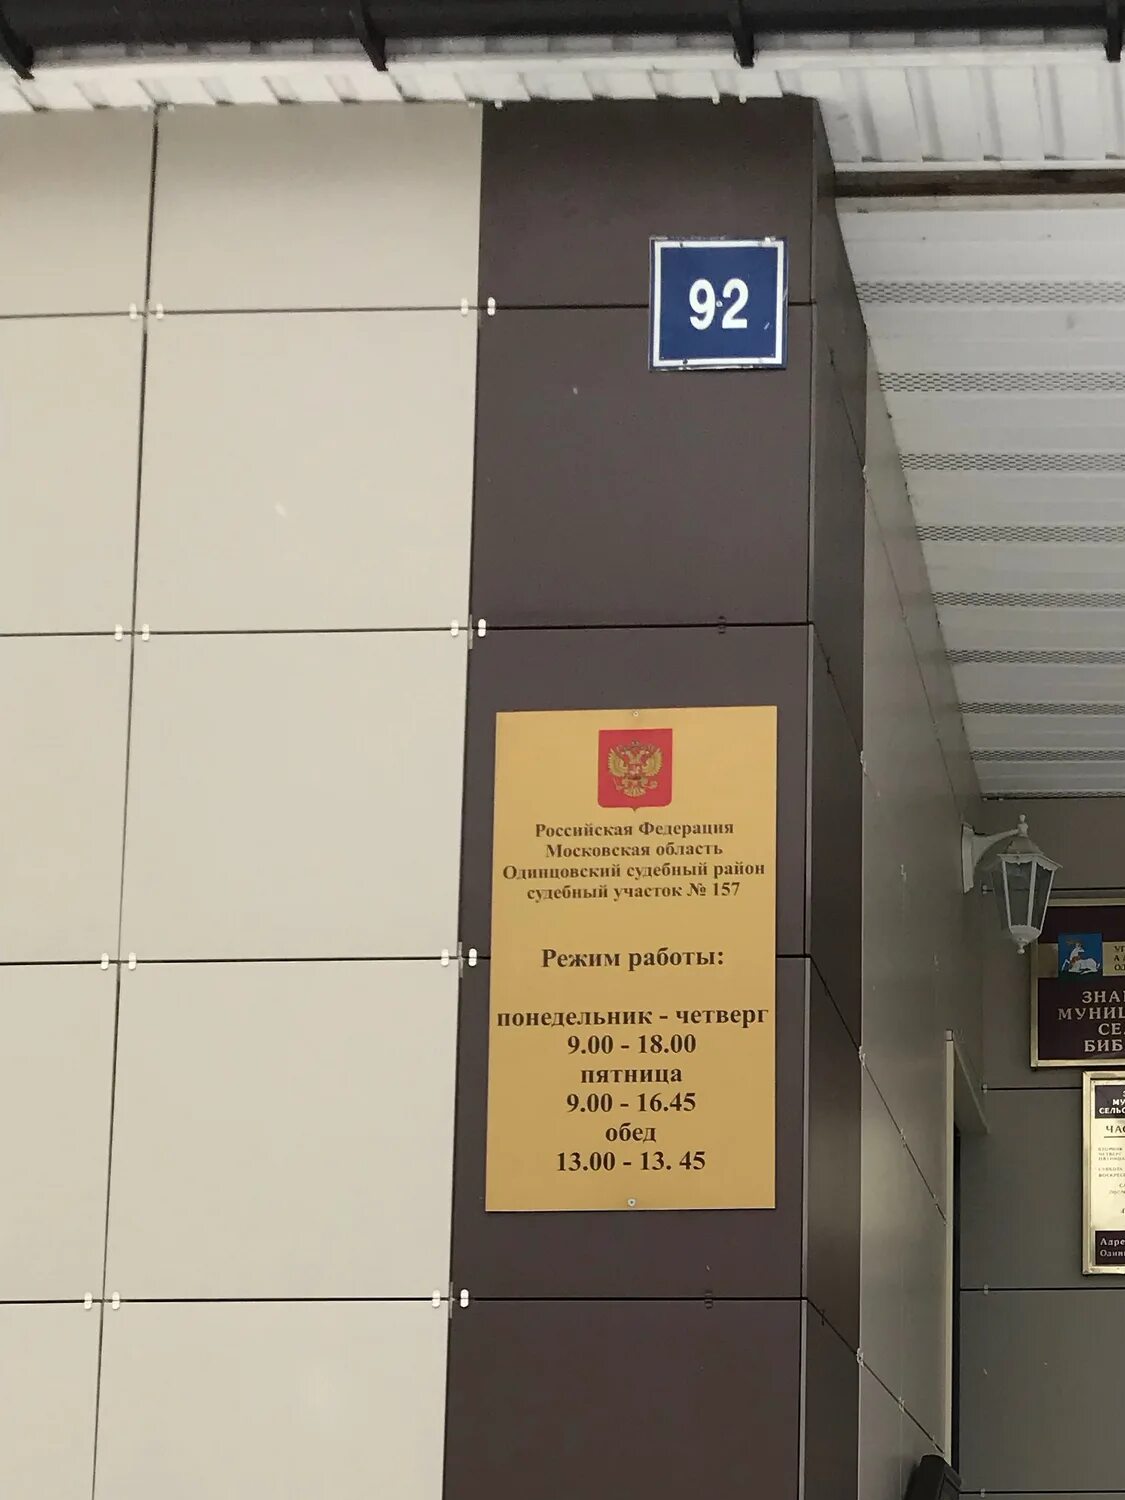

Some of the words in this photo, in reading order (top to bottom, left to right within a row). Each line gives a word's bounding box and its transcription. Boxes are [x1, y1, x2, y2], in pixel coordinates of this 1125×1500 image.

[688, 277, 749, 330] 92
[534, 822, 633, 839] Российская
[638, 821, 734, 838] Федерация
[545, 842, 651, 859] Московская
[655, 841, 723, 856] область
[502, 863, 621, 881] Одинцовский
[626, 862, 708, 880] судебный
[713, 861, 766, 879] район
[526, 883, 608, 902] судебный
[613, 883, 682, 901] участок
[686, 882, 707, 897] №
[711, 881, 740, 897] 157
[540, 947, 621, 969] Режим
[627, 946, 725, 971] работы:
[496, 1010, 653, 1029] понедельник
[675, 1007, 769, 1028] четверг
[566, 1035, 614, 1055] 9.00
[637, 1033, 697, 1054] 18.00
[579, 1067, 683, 1086] пятница
[566, 1093, 614, 1113] 9.00
[637, 1092, 697, 1112] 16.45
[604, 1123, 657, 1144] обед
[556, 1152, 616, 1172] 13.00
[678, 1150, 706, 1170] 45
